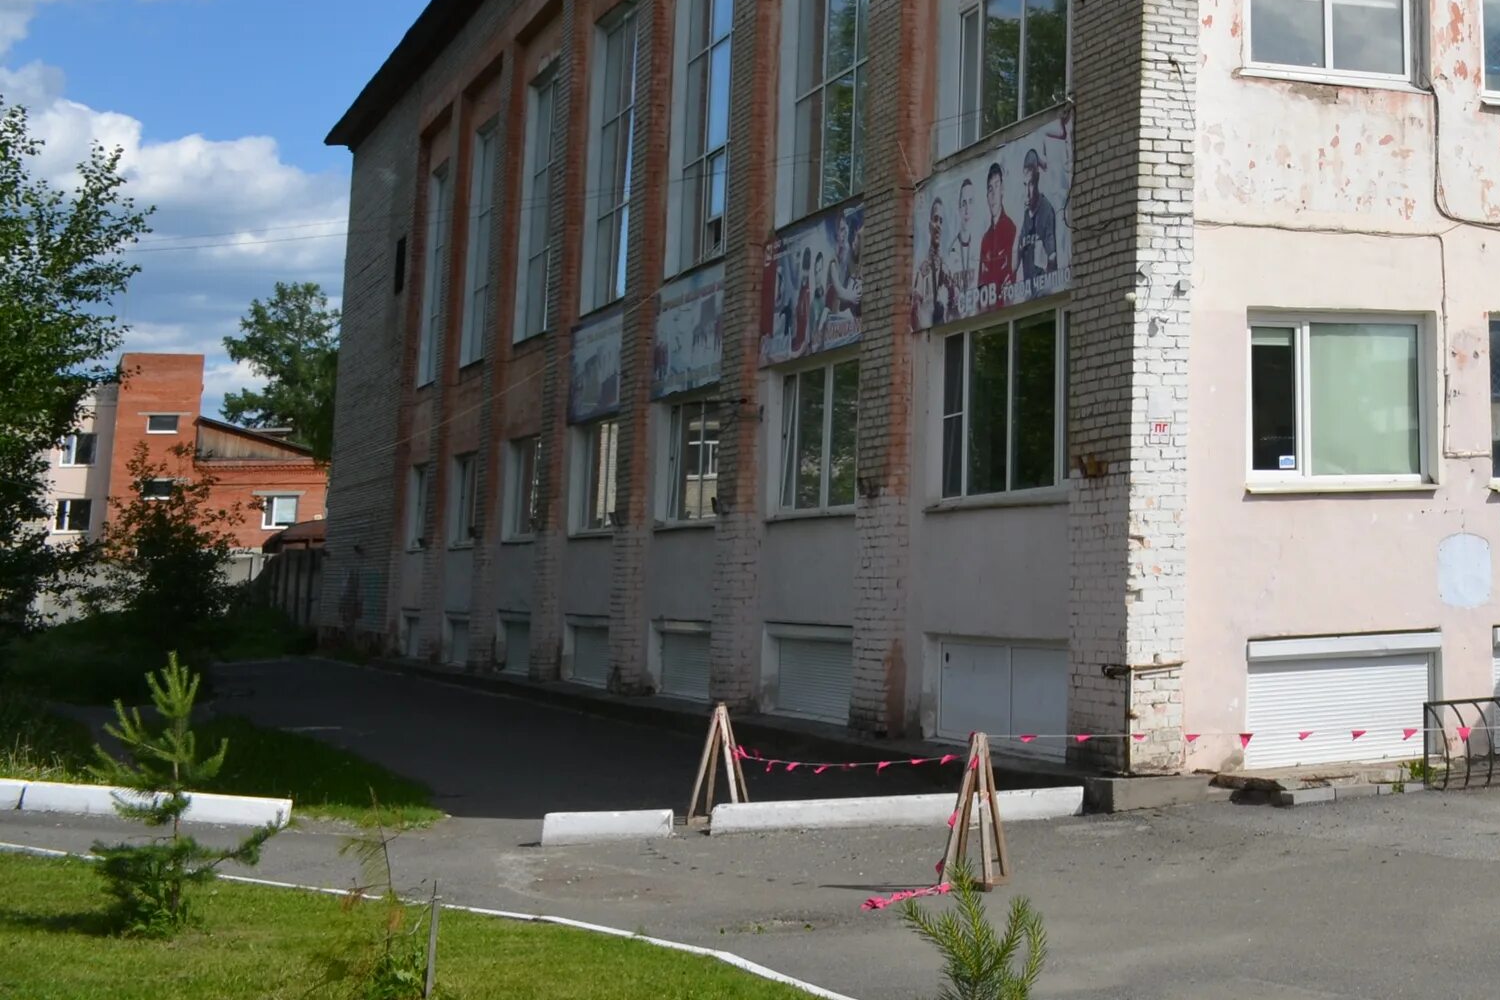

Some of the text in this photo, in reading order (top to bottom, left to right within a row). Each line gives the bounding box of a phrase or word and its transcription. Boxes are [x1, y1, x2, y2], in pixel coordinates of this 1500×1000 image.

[957, 282, 998, 314] СЕРОВ
[1003, 281, 1032, 302] ГОРОД
[1154, 423, 1168, 433] ПГ
